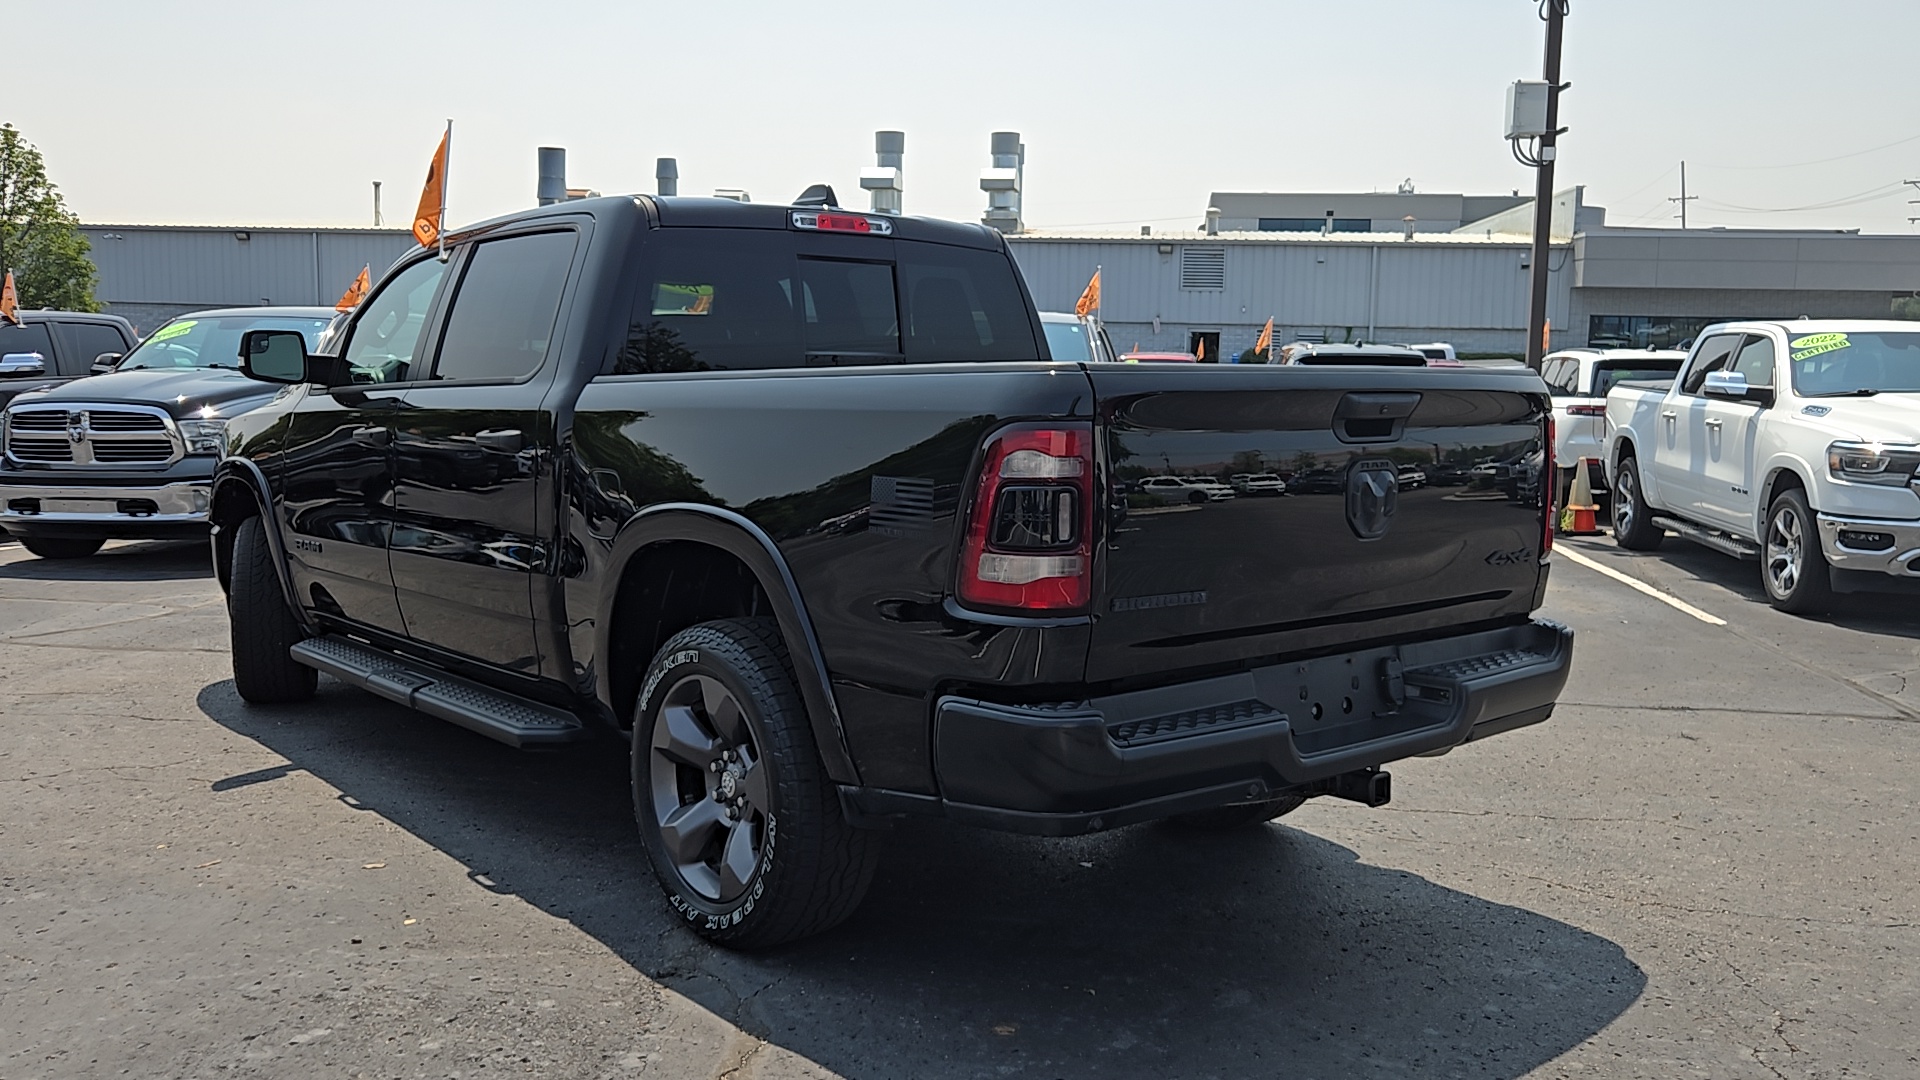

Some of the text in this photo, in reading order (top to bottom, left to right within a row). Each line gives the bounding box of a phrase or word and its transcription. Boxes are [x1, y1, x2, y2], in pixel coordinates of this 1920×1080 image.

[1801, 334, 1837, 347] 2022
[1794, 341, 1847, 360] CERTIFIED
[1360, 462, 1389, 470] RAM
[868, 526, 890, 536] BUILT
[893, 529, 903, 537] TO
[295, 538, 323, 554] RAM
[640, 649, 699, 712] FALKEN
[704, 812, 777, 930] WILDPEAK
